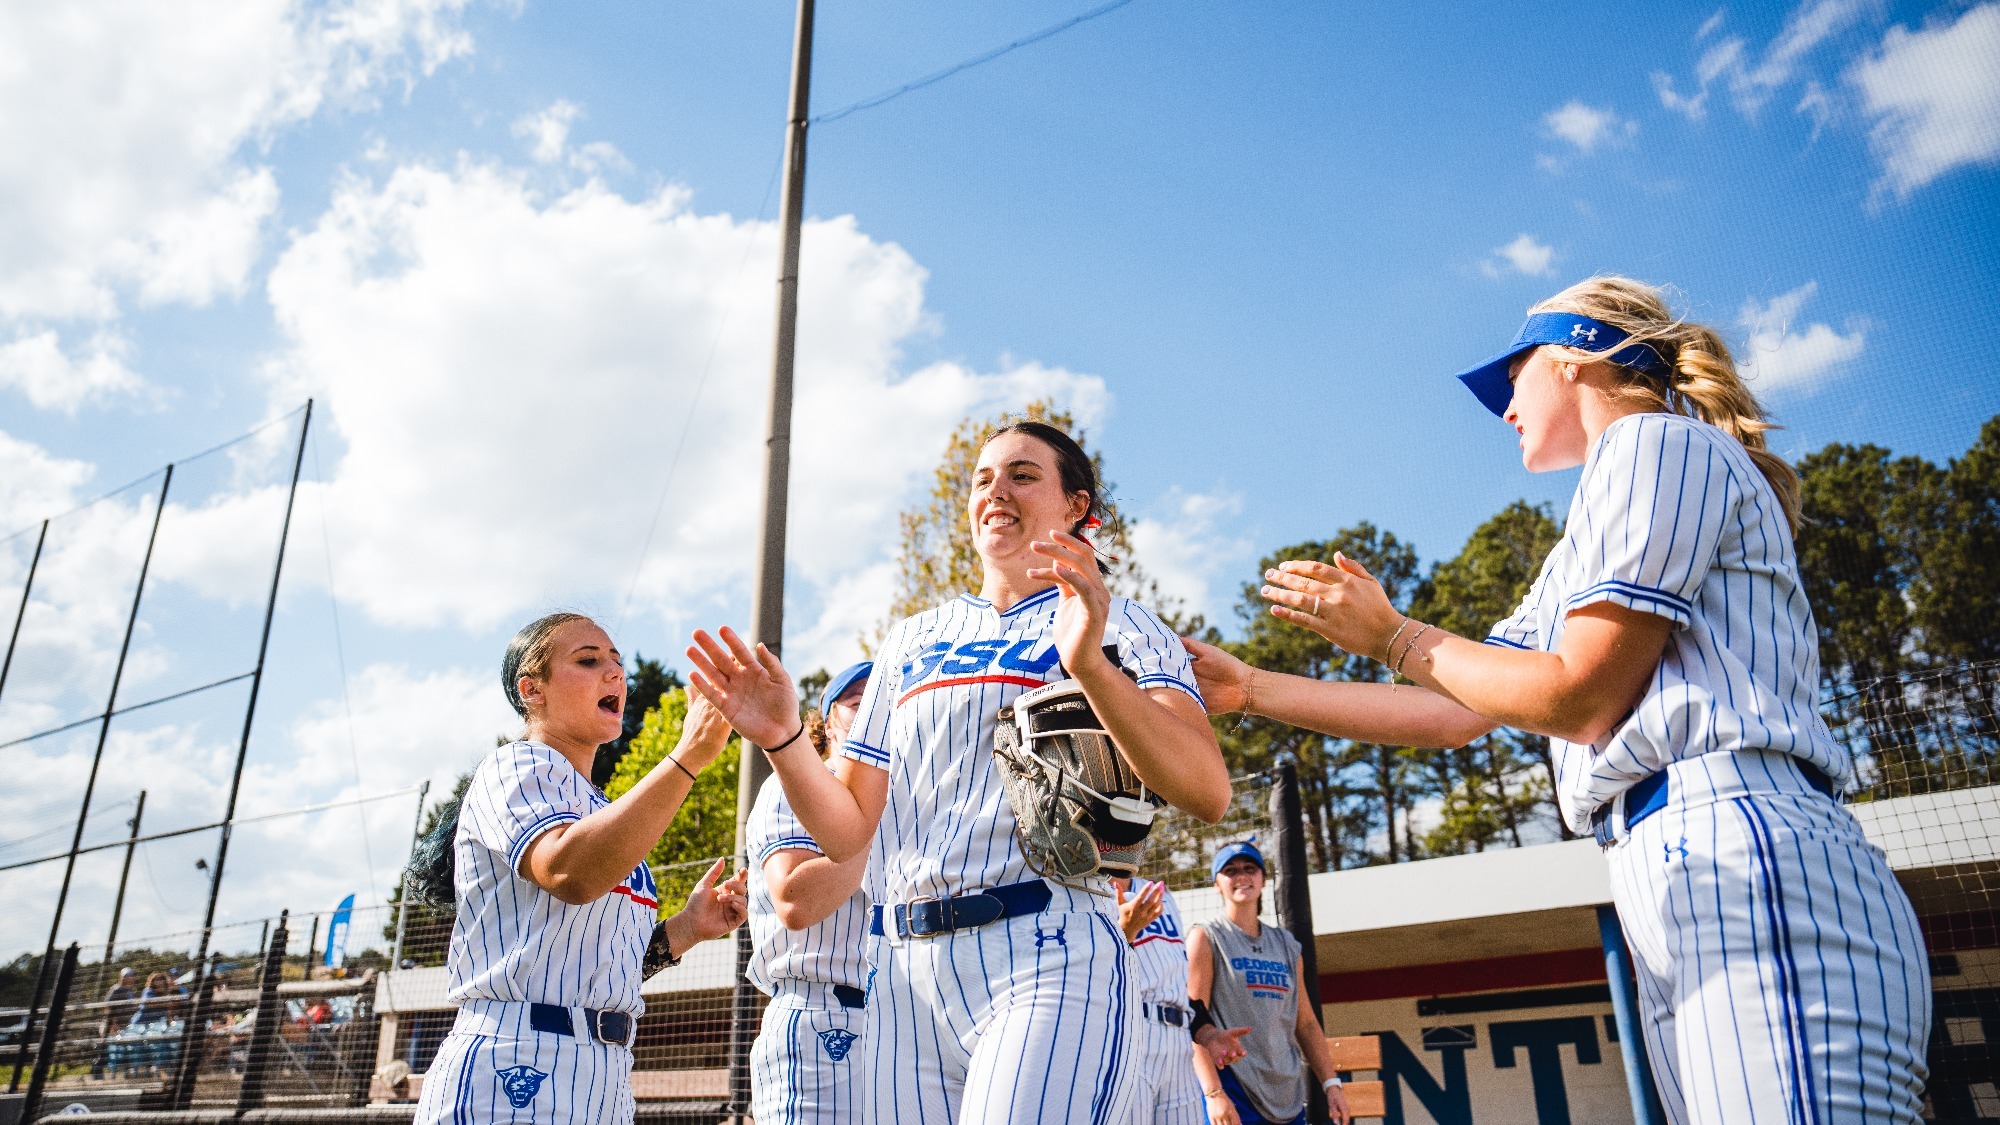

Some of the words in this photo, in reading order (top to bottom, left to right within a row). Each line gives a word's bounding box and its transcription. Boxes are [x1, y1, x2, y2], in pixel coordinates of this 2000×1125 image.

[900, 639, 1060, 693] GSU
[1135, 914, 1179, 939] SU
[1245, 970, 1289, 988] STATE
